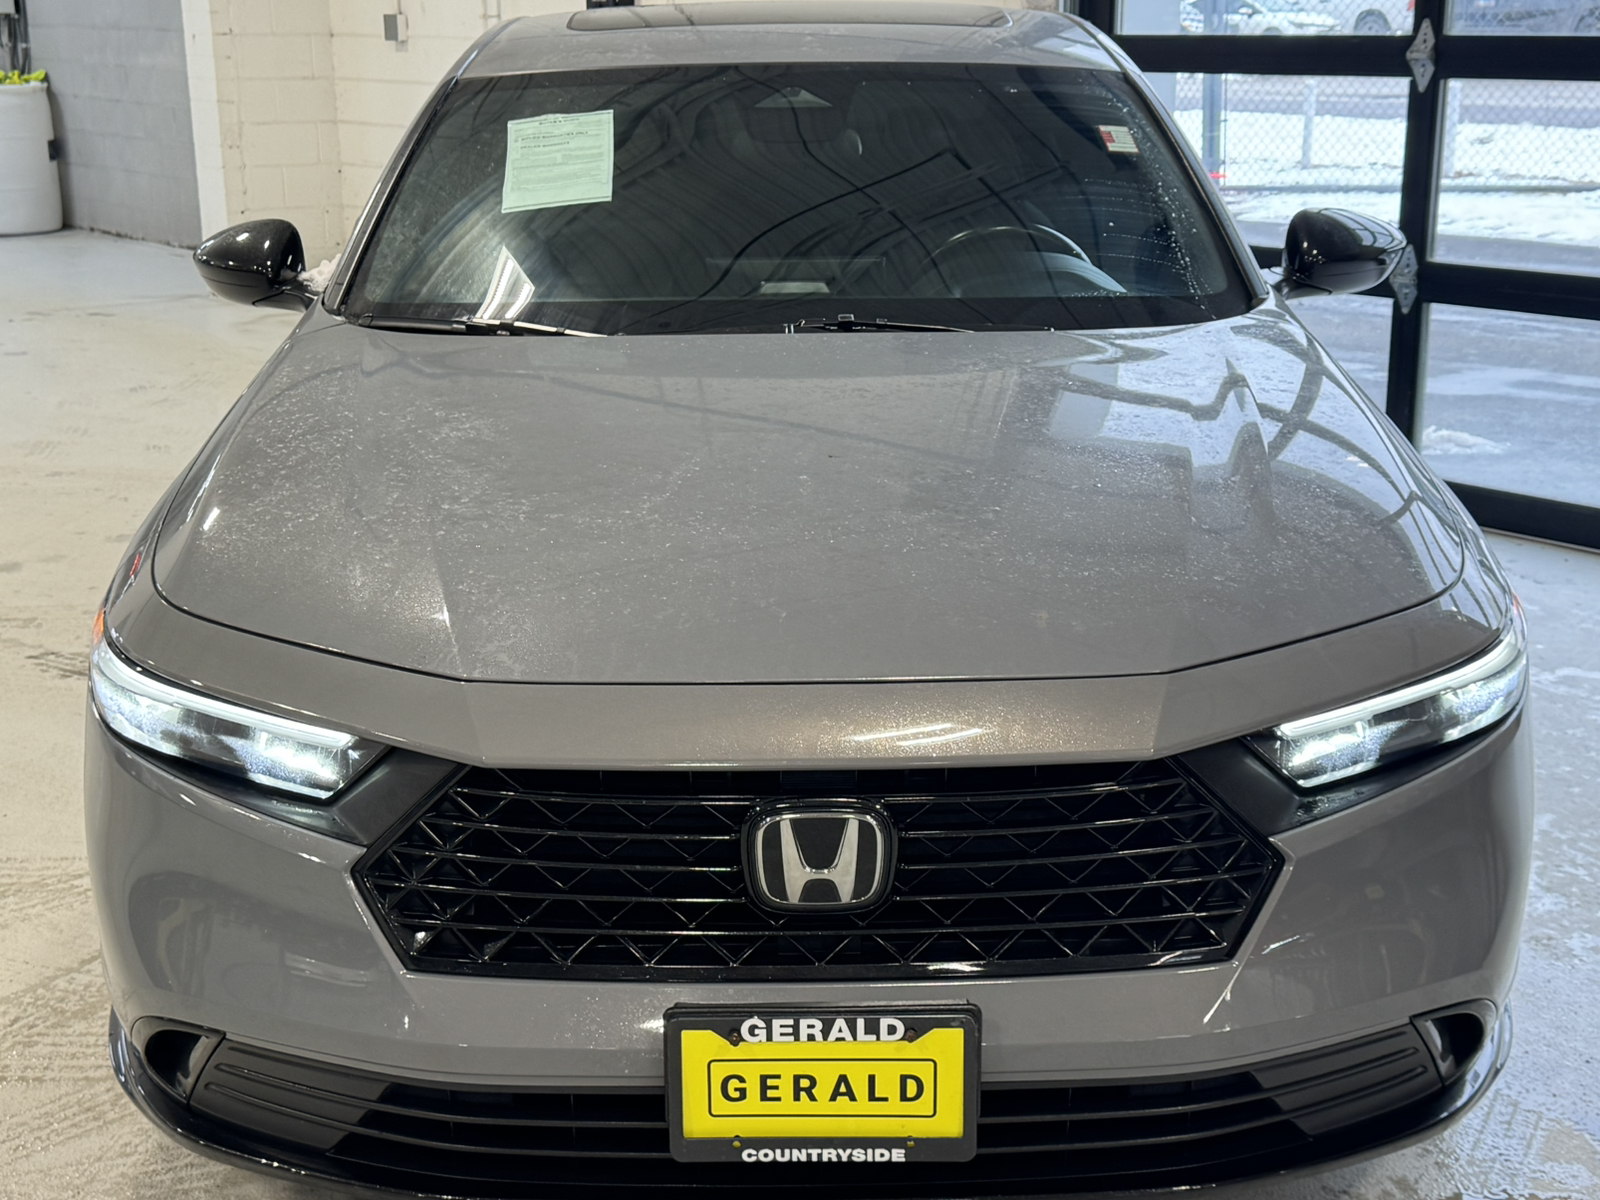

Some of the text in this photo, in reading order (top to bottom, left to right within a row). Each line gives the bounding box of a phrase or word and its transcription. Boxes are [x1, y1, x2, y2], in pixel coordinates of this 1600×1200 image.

[740, 1017, 906, 1043] GERALD
[720, 1073, 925, 1103] GERALD
[741, 1147, 906, 1163] COUNTRYSIDE
